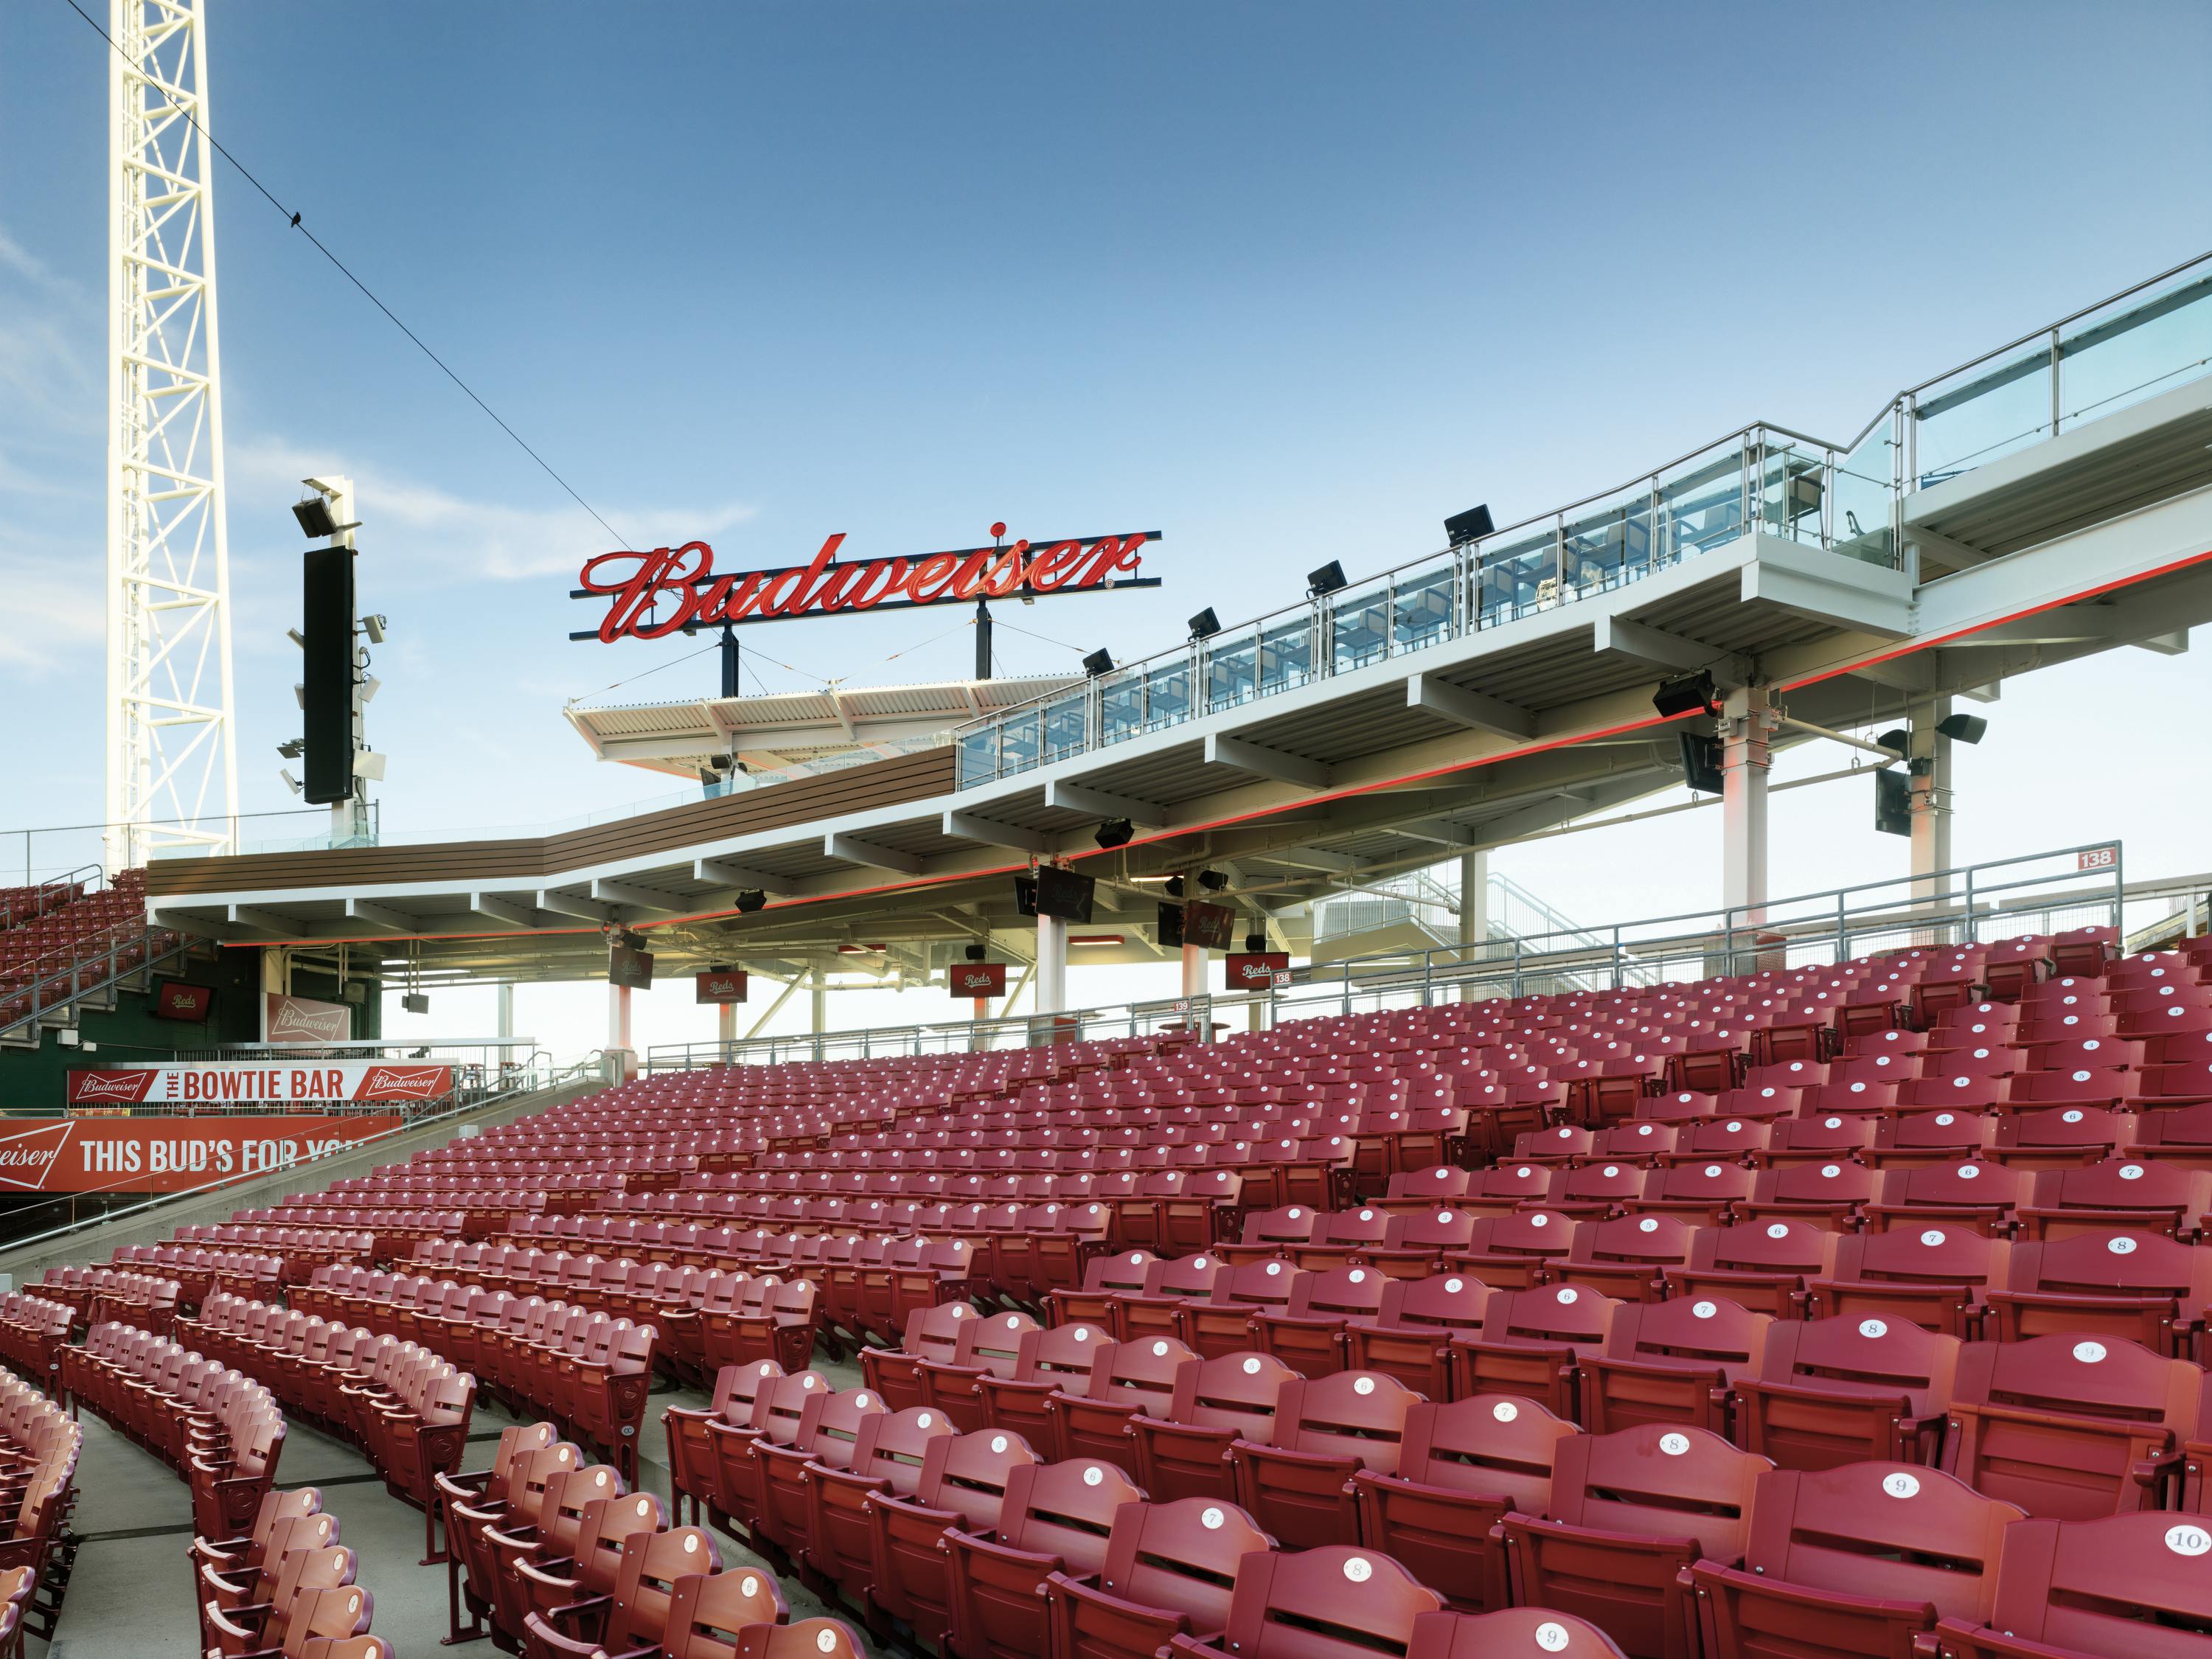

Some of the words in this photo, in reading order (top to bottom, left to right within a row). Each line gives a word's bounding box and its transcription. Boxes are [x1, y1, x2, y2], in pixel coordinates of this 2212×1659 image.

[580, 522, 1148, 643] Budweiser
[2081, 849, 2112, 869] 138
[1242, 962, 1271, 979] Reds
[964, 973, 991, 988] Reds
[1276, 973, 1290, 983] 138
[709, 980, 734, 994] Reds
[172, 994, 196, 1008] Reds
[1175, 1002, 1188, 1011] 139
[278, 1008, 338, 1032] Budweiser
[82, 1079, 139, 1093] Budweiser
[167, 1071, 179, 1099] THE
[184, 1071, 281, 1100] BOWTIE
[291, 1069, 344, 1099] BAR
[372, 1074, 436, 1089] Budweiser
[80, 1140, 142, 1172] THIS
[150, 1138, 233, 1173] BUD'S
[242, 1138, 298, 1172] FOR
[2118, 1242, 2126, 1250] 8
[1701, 1306, 1708, 1314] 7
[1868, 1324, 1877, 1333] 8
[2085, 1348, 2094, 1357] 9
[1361, 1382, 1367, 1390] 6
[1502, 1408, 1509, 1416] 7
[1669, 1439, 1679, 1450] 8
[1090, 1472, 1096, 1481] 6
[1896, 1480, 1907, 1492] 9
[1210, 1513, 1217, 1523] 7
[2174, 1532, 2202, 1548] 10
[1352, 1564, 1362, 1576] 8
[824, 1635, 830, 1646] 7
[1548, 1630, 1557, 1644] 9
